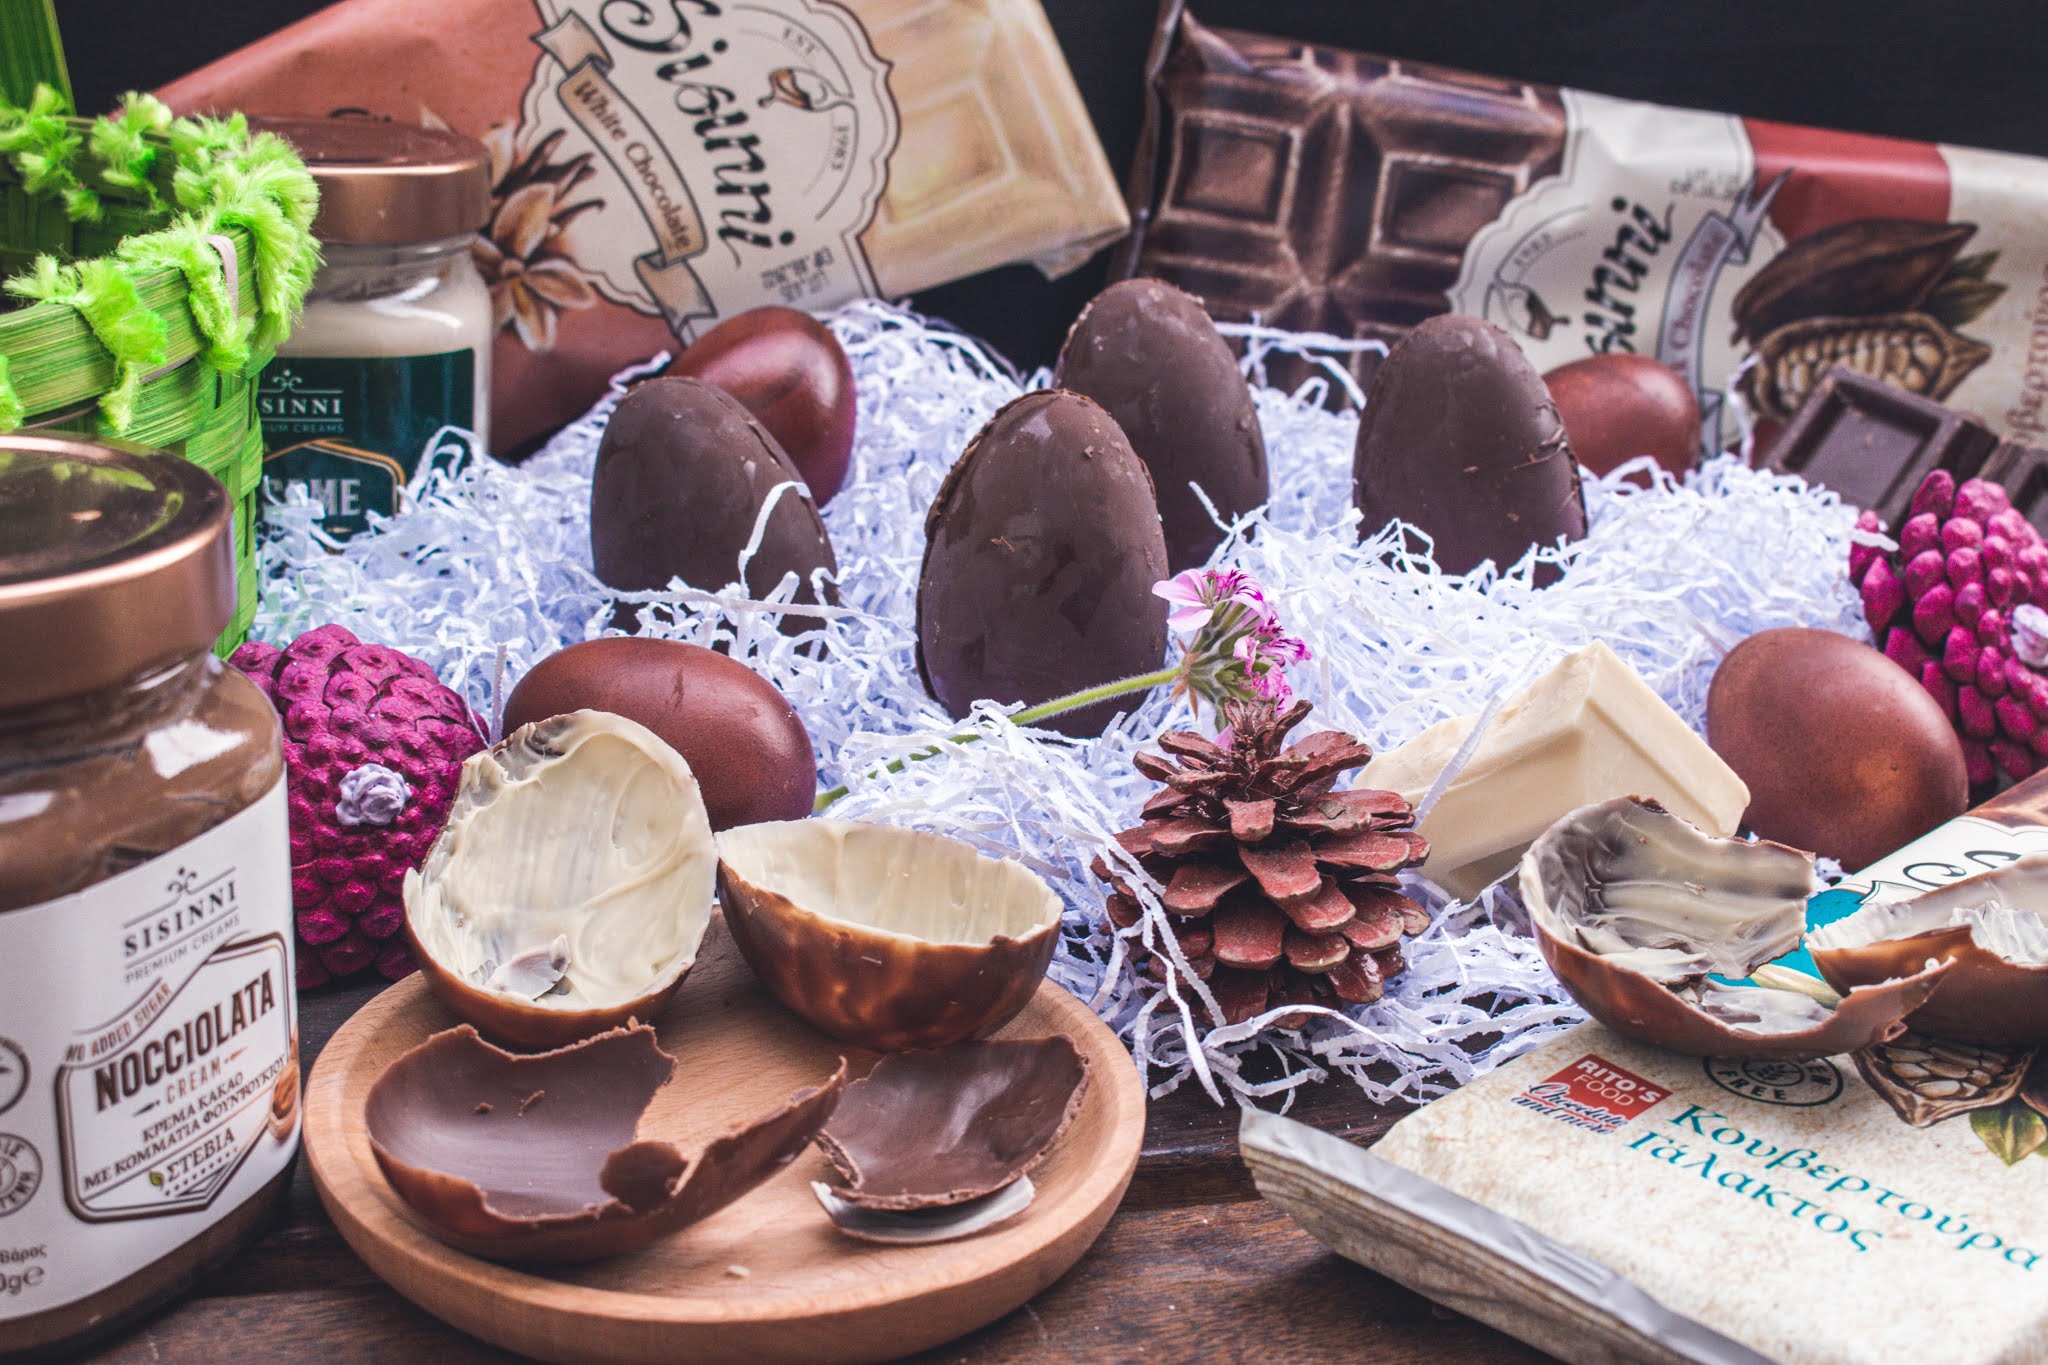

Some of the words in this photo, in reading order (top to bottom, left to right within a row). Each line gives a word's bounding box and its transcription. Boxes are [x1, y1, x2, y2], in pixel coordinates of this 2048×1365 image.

[574, 80, 628, 141] White
[624, 142, 691, 250] Chocolate
[260, 398, 343, 415] SINNI
[124, 881, 237, 958] SISINNI
[125, 944, 188, 983] PREMIUM
[193, 915, 240, 951] CREAMS
[65, 1043, 86, 1062] NO
[92, 1020, 132, 1057] ADDED
[134, 983, 171, 1027] SUGAR
[94, 968, 276, 1113] NOCCIOLATA
[142, 1104, 197, 1143] ΚΡΕΜΑ
[199, 1071, 245, 1109] ΚΑΚΑΟ
[166, 1056, 222, 1104] CREAM
[1527, 1082, 1629, 1126] Chocolate
[1572, 1073, 1635, 1106] FOOD
[1576, 1059, 1662, 1104] RITO'S
[1716, 1070, 1787, 1100] FREE
[1510, 1096, 1564, 1116] and
[1554, 1113, 1615, 1135] more
[165, 1126, 237, 1183] ΣΤΕΒΙΑ
[1626, 1131, 1883, 1252] Γάλακτος
[1667, 1103, 2044, 1271] Κουβερτούρα
